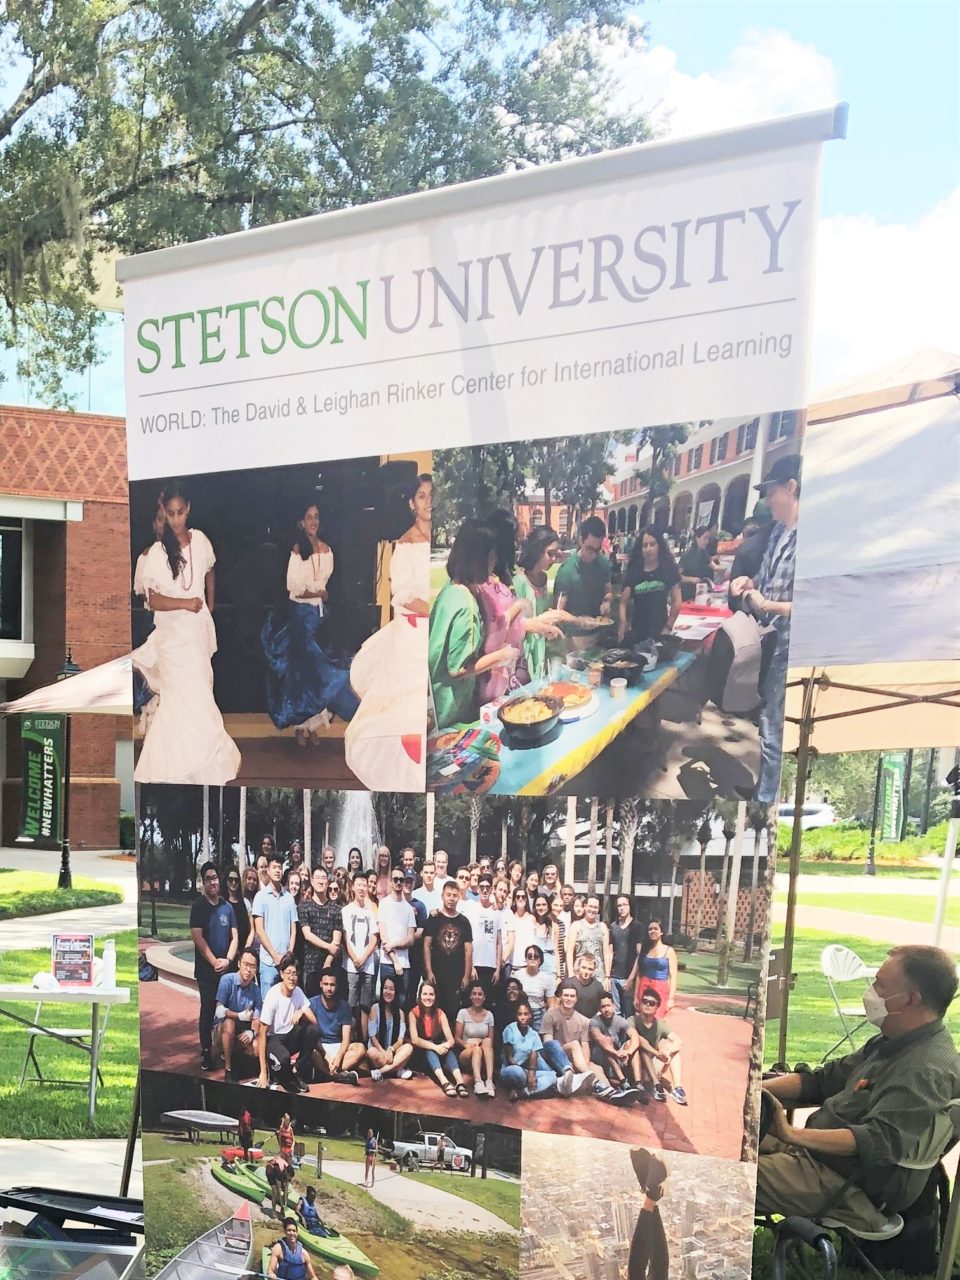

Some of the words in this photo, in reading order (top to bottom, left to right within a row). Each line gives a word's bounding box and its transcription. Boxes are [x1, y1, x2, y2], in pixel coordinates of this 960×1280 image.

[137, 280, 371, 375] STETSON
[380, 200, 802, 334] UNIVERSITY
[140, 411, 207, 435] WORLD:
[211, 402, 240, 426] The
[246, 396, 290, 422] David
[296, 396, 308, 416] &
[314, 389, 380, 416] Leighan
[387, 378, 445, 405] Rinker
[451, 370, 514, 397] Center
[520, 363, 548, 388] for
[554, 343, 685, 382] International
[693, 331, 794, 365] Learning
[24, 751, 40, 836] WELCOME
[40, 737, 54, 837] #NEWHATTERS
